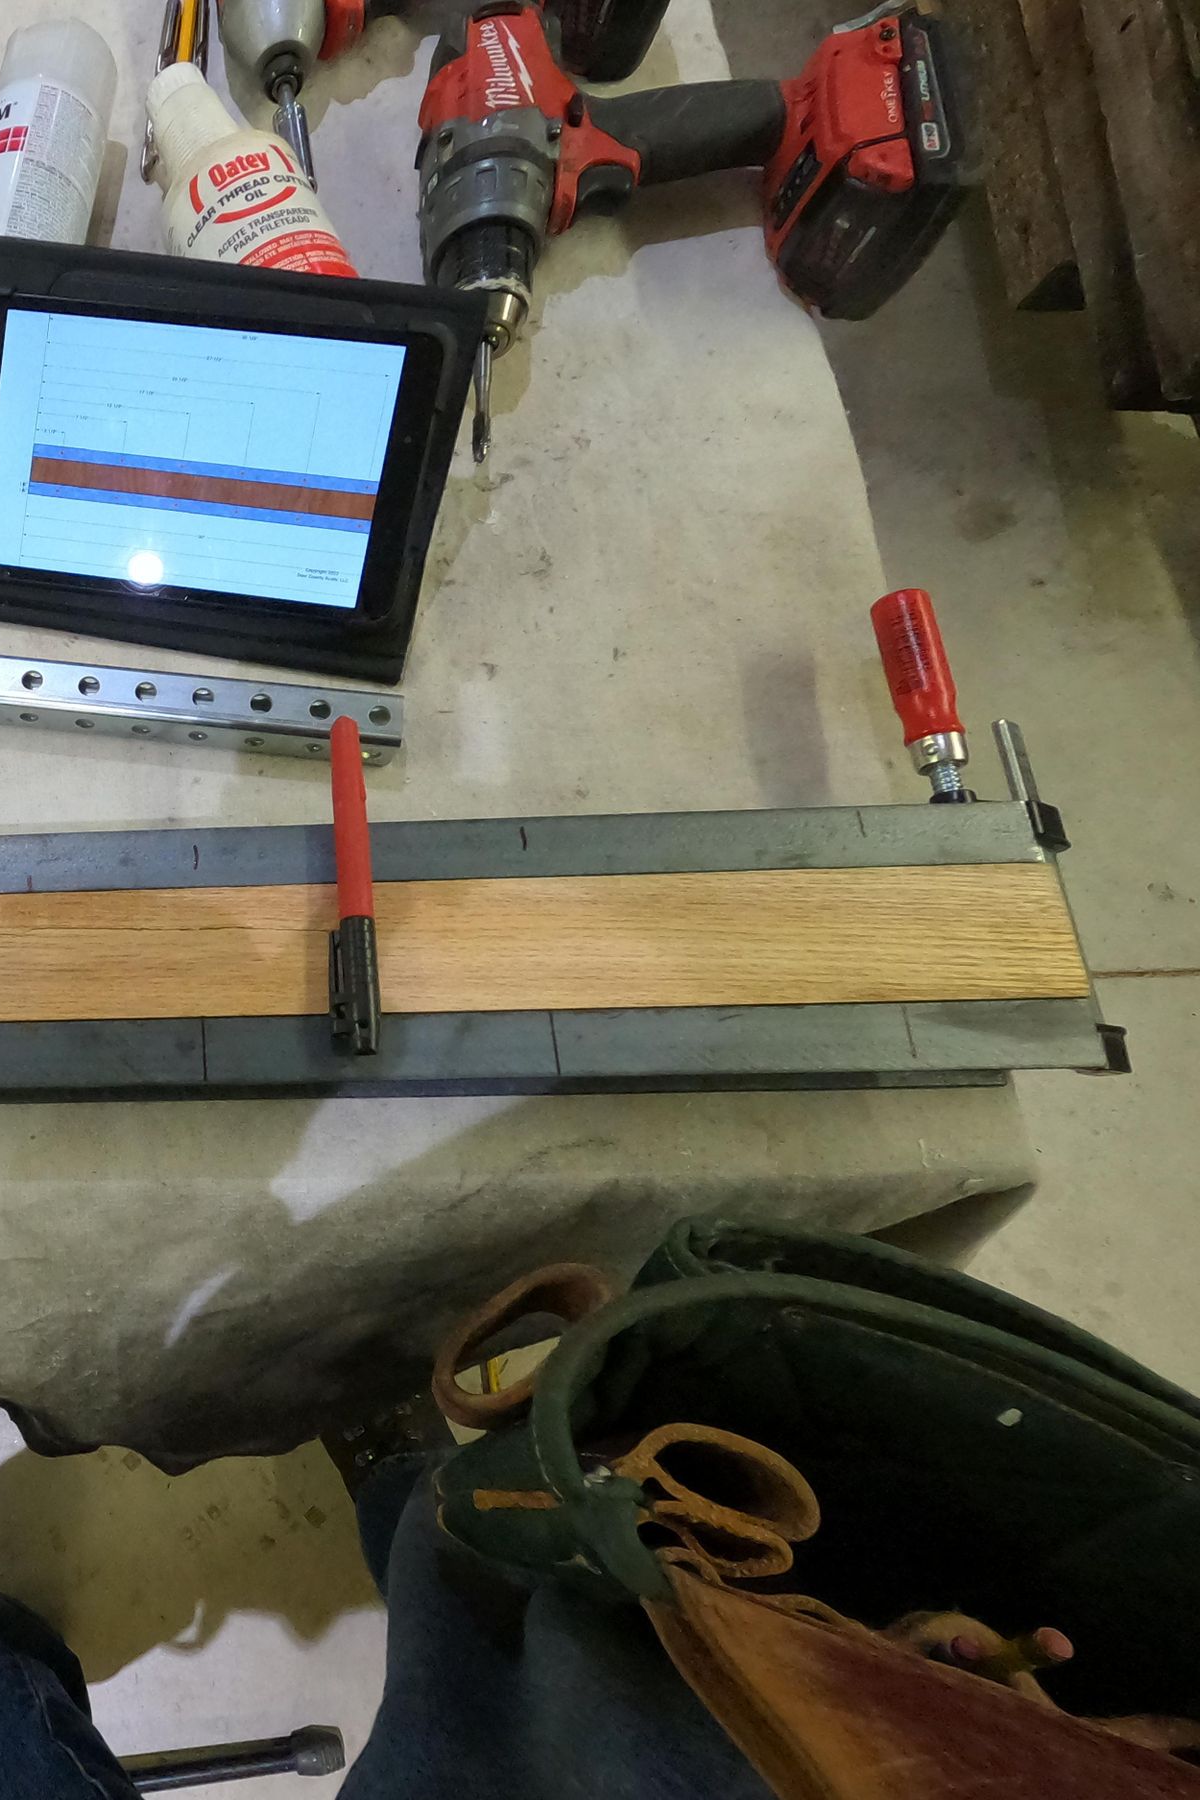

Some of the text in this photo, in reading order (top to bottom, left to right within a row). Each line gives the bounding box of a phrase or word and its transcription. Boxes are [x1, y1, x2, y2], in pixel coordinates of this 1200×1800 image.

[477, 20, 520, 108] Milwaukee
[208, 152, 270, 188] Oatey
[187, 206, 217, 248] CLEAR
[217, 176, 270, 208] THREAD
[244, 189, 267, 203] OIL
[217, 226, 247, 258] ACEITE
[233, 215, 311, 253] PARA FILETEADO
